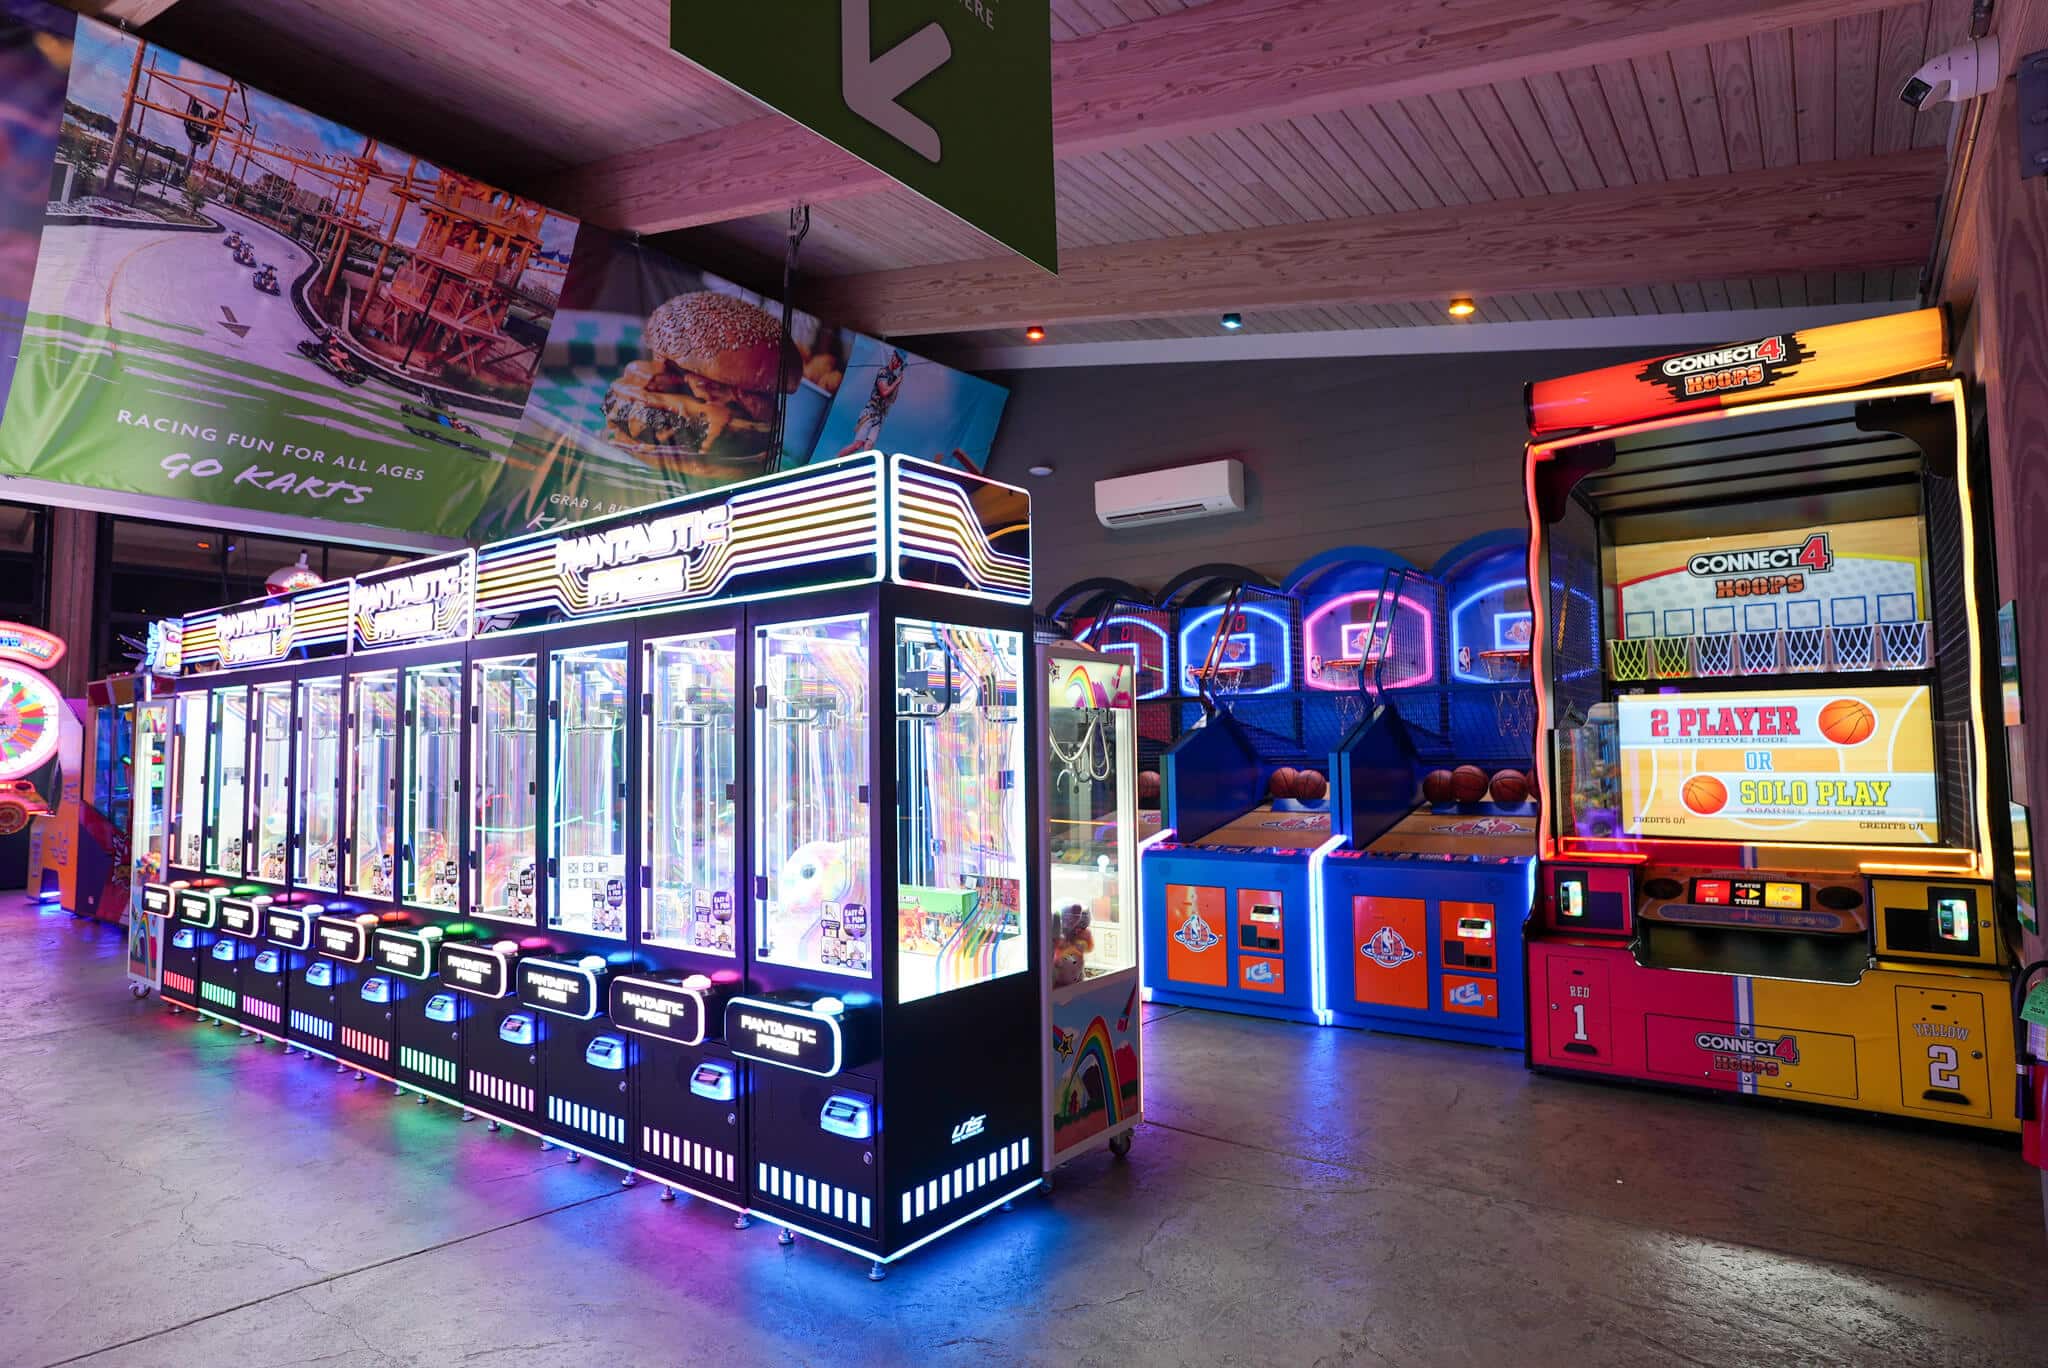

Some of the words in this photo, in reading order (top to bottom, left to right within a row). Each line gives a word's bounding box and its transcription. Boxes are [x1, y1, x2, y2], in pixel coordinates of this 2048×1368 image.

[1687, 364, 1763, 394] HOOPS
[116, 409, 217, 442] RACING
[227, 433, 275, 454] FUN
[283, 443, 325, 464] FOR
[333, 455, 368, 472] ALL
[376, 463, 425, 481] AGES
[159, 452, 224, 479] GO
[233, 464, 373, 505] KARTS
[550, 493, 589, 509] GRAB
[592, 501, 602, 513] A
[1716, 573, 1804, 599] HOOPS
[1651, 709, 1669, 737] 2
[1678, 706, 1800, 737] PLAYER
[1745, 751, 1773, 771] OR
[1740, 780, 1808, 806] SOLO
[1817, 780, 1891, 807] PLAY
[1450, 982, 1482, 1004] ICE
[1570, 985, 1590, 998] RED
[1574, 1004, 1587, 1040] 1
[1912, 1023, 1969, 1041] YELLOW
[1715, 1055, 1779, 1077] HOOPS
[1928, 1044, 1960, 1090] 2
